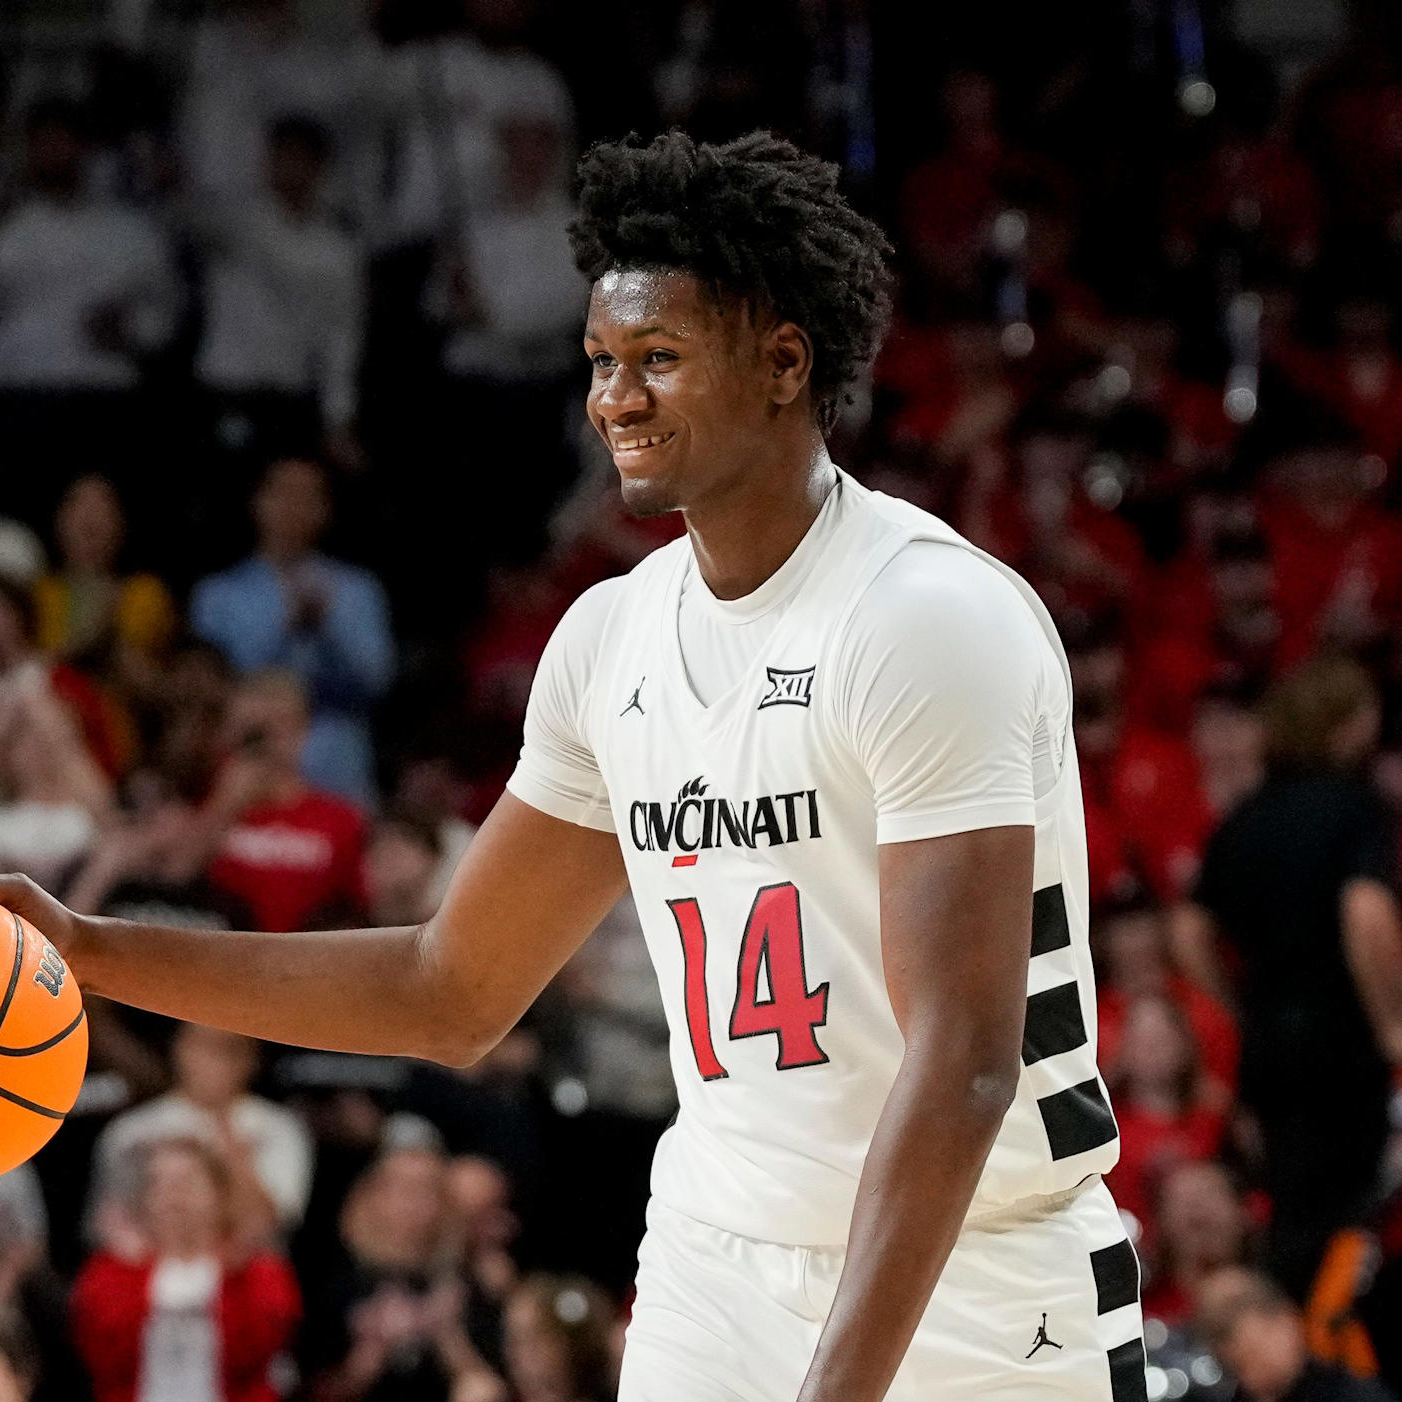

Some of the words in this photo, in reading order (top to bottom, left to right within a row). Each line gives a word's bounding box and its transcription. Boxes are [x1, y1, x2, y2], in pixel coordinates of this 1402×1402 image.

[760, 666, 816, 708] XII
[630, 784, 822, 852] CINCINNATI
[665, 881, 830, 1081] 14
